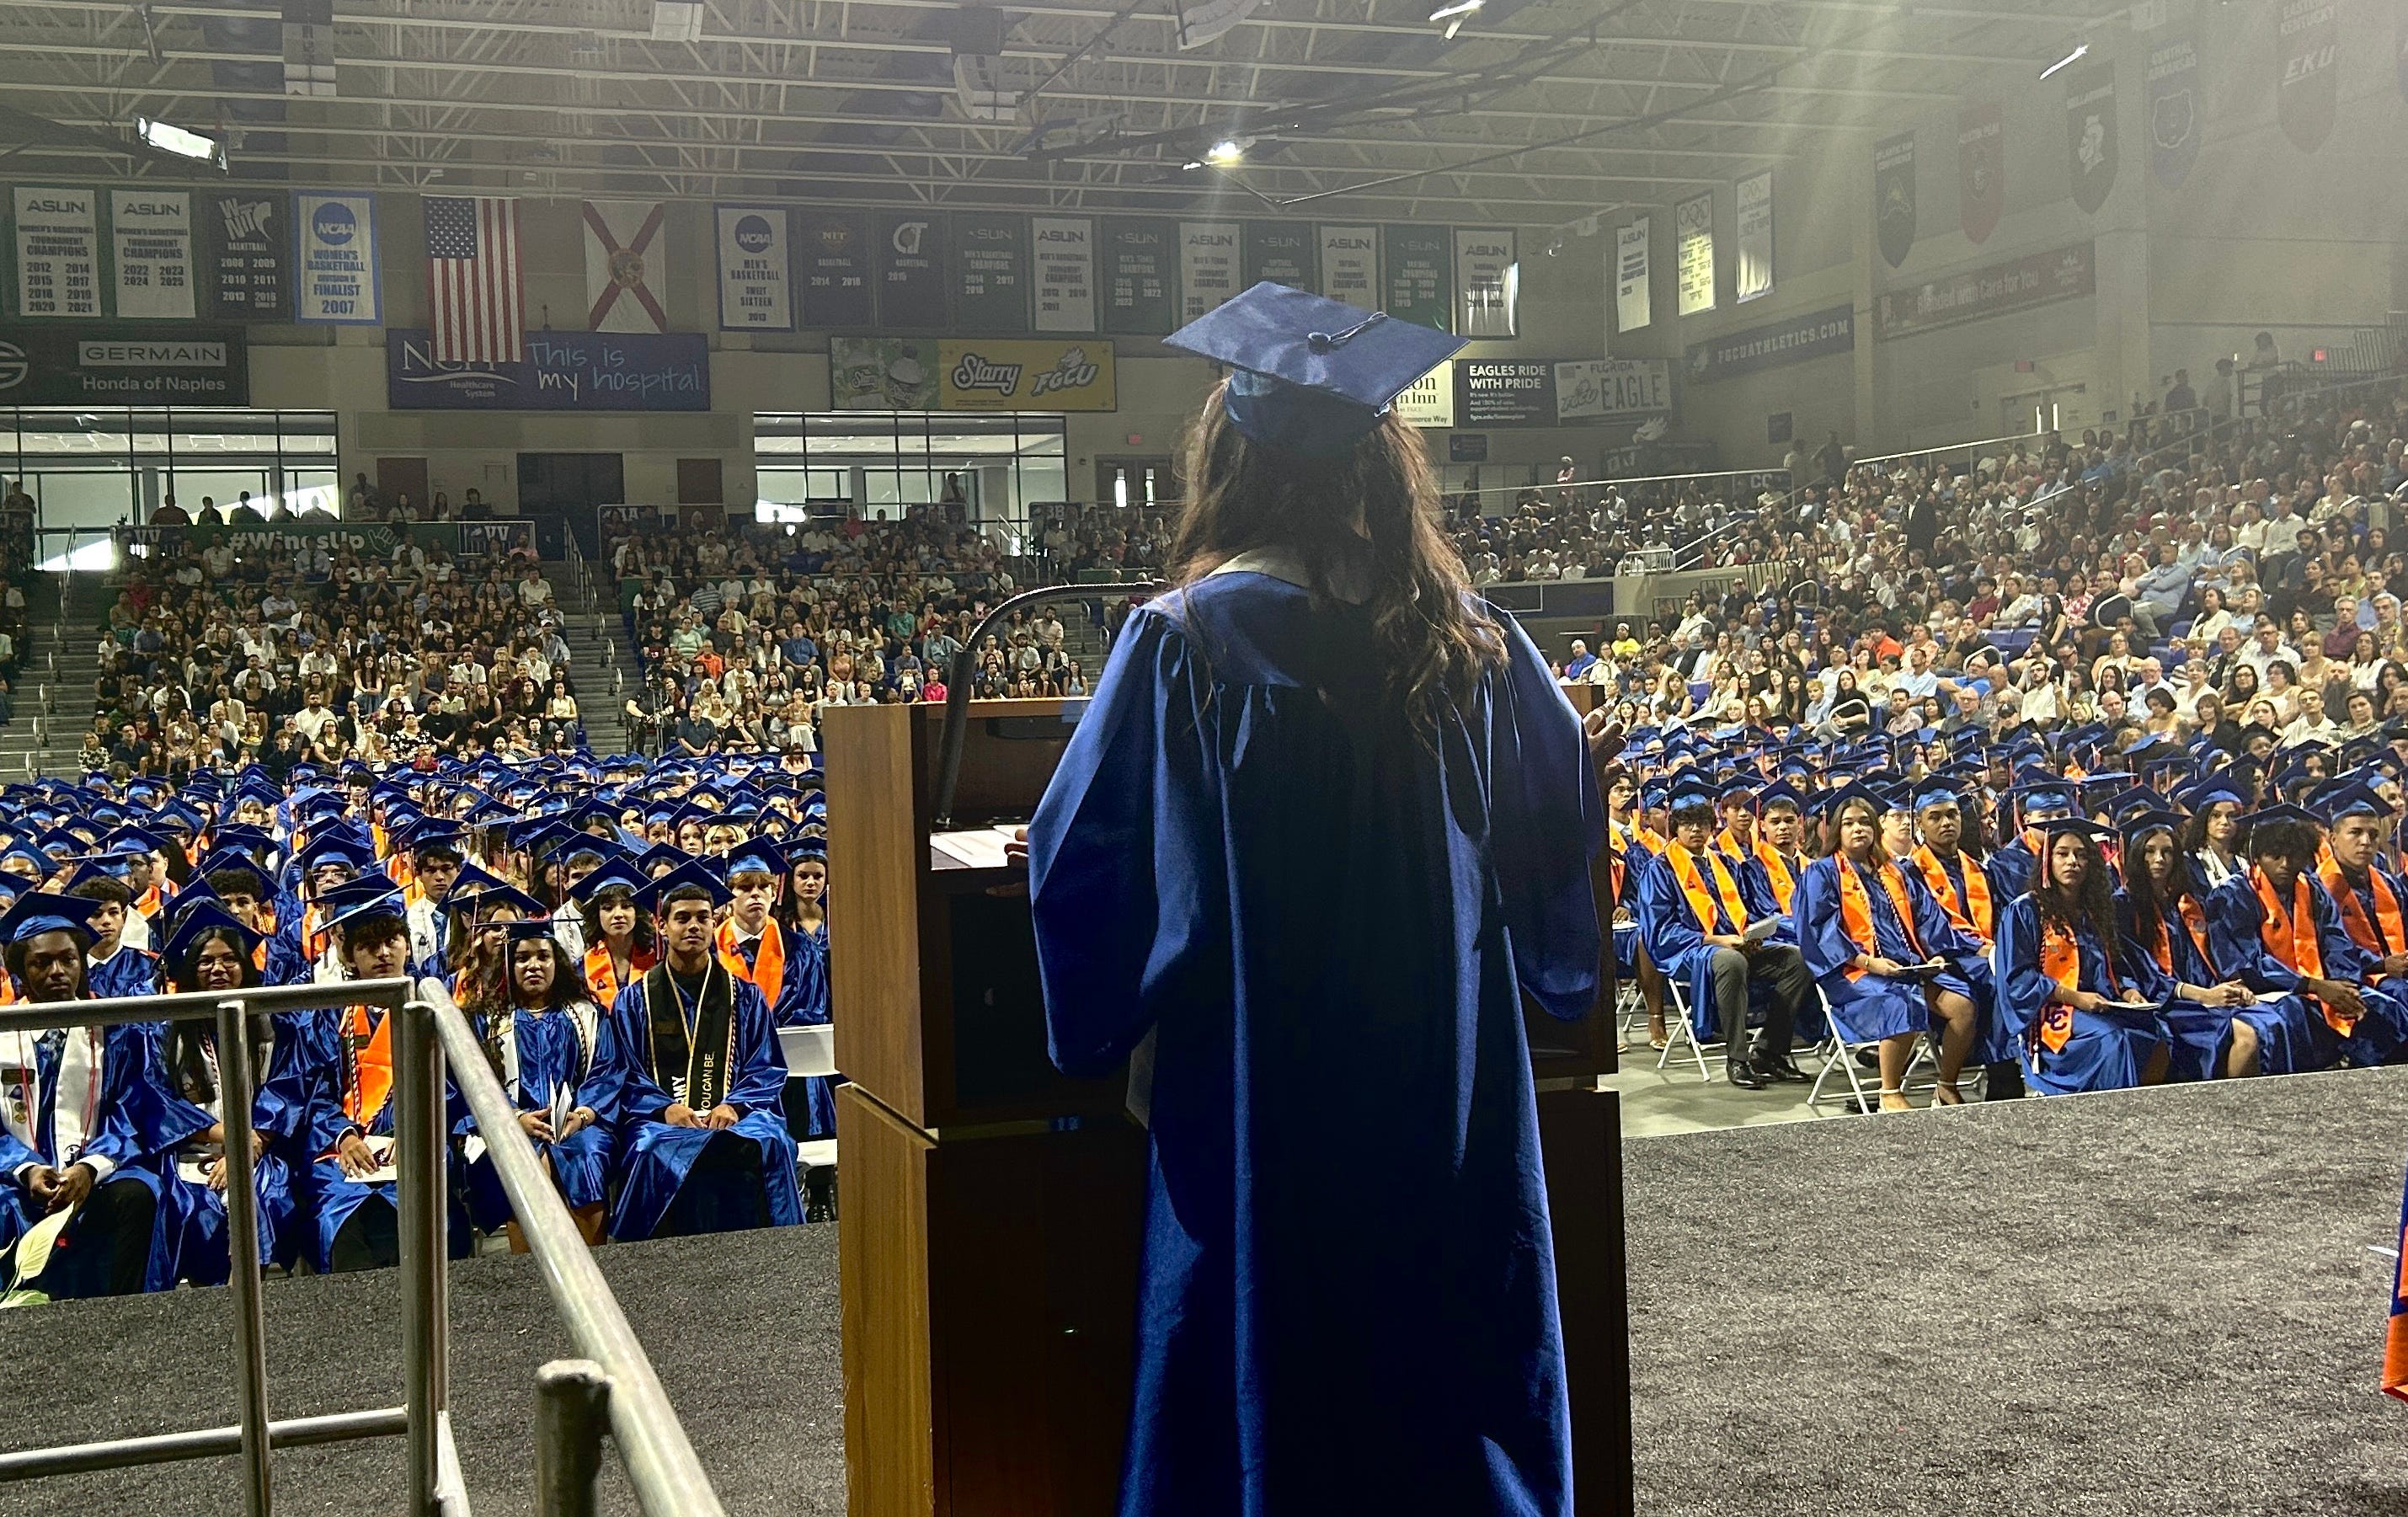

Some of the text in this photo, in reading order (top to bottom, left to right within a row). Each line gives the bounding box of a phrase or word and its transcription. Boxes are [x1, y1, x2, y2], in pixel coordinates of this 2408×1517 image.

[2285, 45, 2335, 78] EKU
[27, 200, 86, 214] ASUN
[123, 203, 180, 216] ASUN
[318, 222, 355, 235] NCAA
[739, 233, 771, 243] NCAA
[822, 232, 847, 240] NIT
[1038, 230, 1084, 243] ASUN
[1188, 234, 1233, 246] ASUN
[1327, 238, 1370, 249] ASUN
[26, 245, 88, 257] CHAMPIONS
[123, 248, 183, 259] CHAMPIONS
[313, 249, 358, 260] WOMEN'S
[1466, 245, 1507, 256] ASUN
[27, 262, 90, 274] 2012 2014
[123, 264, 184, 275] 2022 2023
[307, 260, 365, 271] BASKETBALL
[744, 259, 767, 269] MEN'S
[27, 275, 89, 286] 2015 2017
[124, 276, 184, 286] 2024 2025
[222, 275, 276, 285] 2010 2011
[731, 270, 780, 280] BASKETBALL
[313, 284, 360, 296] FINALIST
[1980, 278, 2003, 299] Care
[2005, 273, 2020, 292] for
[2020, 269, 2039, 289] You
[29, 302, 93, 312] 2020 2021
[322, 300, 355, 313] 2007
[740, 296, 772, 307] SIXTEEN
[1717, 319, 1849, 365] FGCUATHLETICS.COM
[86, 346, 221, 361] GERMAIN
[526, 341, 587, 367] This
[604, 342, 625, 367] is
[1469, 365, 1546, 377] EAGLES RIDE
[1590, 362, 1634, 374] FLORIDA
[952, 354, 1098, 397] Starry FGCU
[83, 377, 226, 393] Honda of Naples
[450, 381, 494, 389] Healthcare
[538, 369, 579, 402] my
[1469, 378, 1541, 389] WITH PRIDE
[465, 389, 495, 398] System
[1412, 392, 1436, 403] Inn
[1600, 374, 1664, 411] EAGLE
[702, 1069, 713, 1092] CAN
